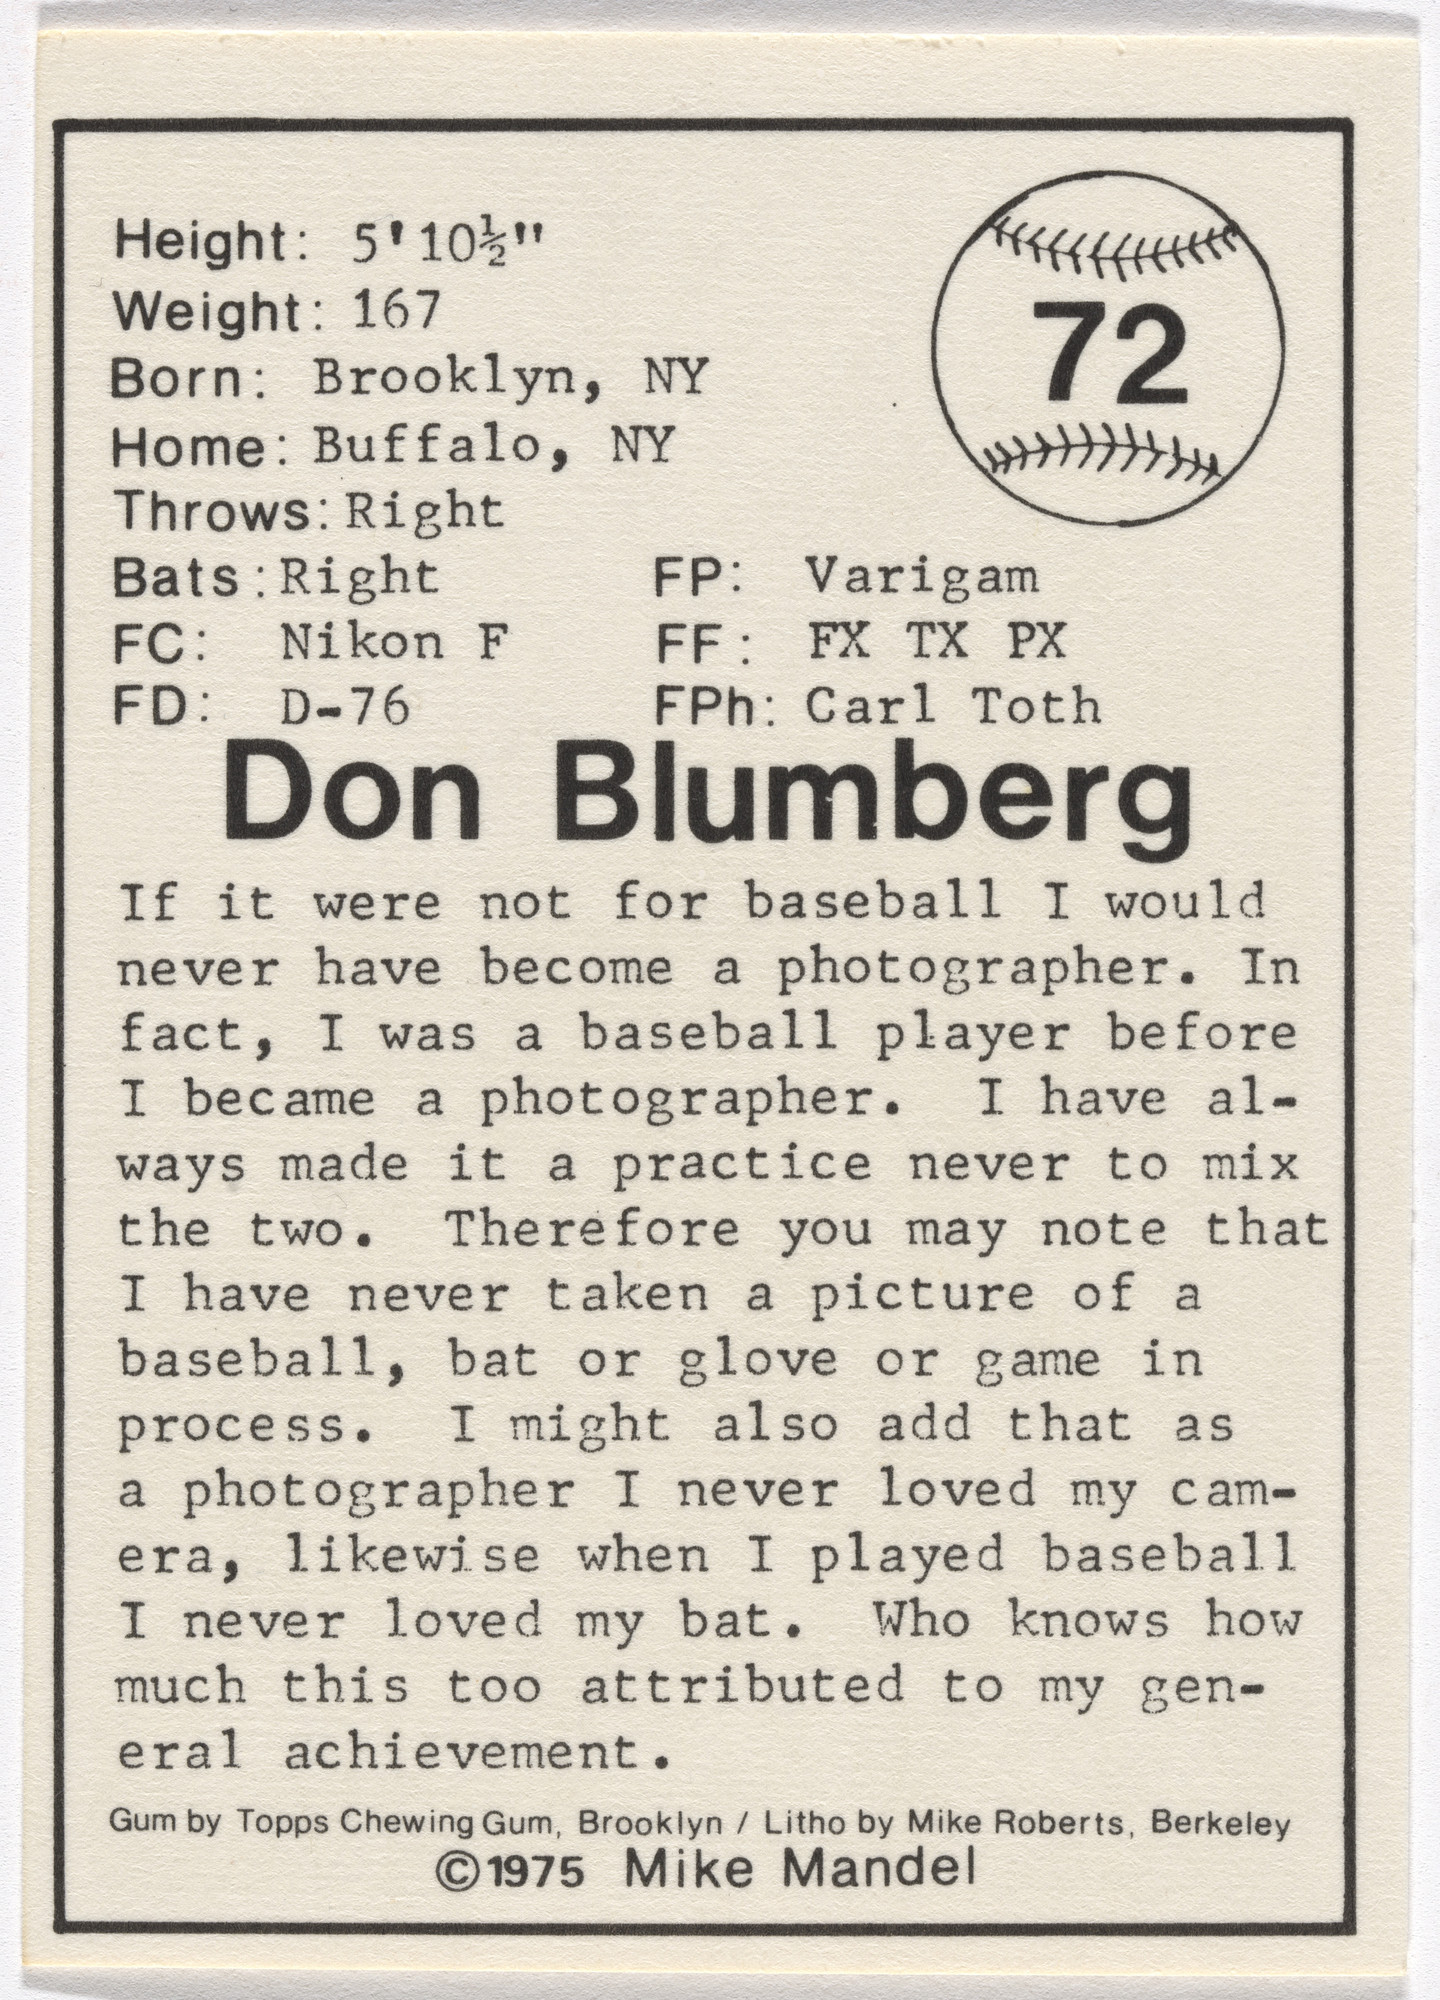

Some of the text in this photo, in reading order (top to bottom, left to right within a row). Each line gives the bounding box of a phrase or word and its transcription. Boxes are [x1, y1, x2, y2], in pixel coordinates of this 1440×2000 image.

[115, 217, 307, 271] Height:
[111, 287, 440, 342] Weight: 167
[110, 352, 710, 406] Born: Brooklyn, NY
[1033, 300, 1189, 405] 72
[112, 420, 676, 473] Home: Buffalo, NY
[113, 487, 505, 541] Throws: Right
[279, 552, 439, 606] Right
[654, 554, 1040, 605] FP: Varigam
[114, 618, 509, 665] FC: Nikon F
[808, 619, 871, 660] FX
[905, 620, 969, 659] TX
[1007, 620, 1068, 659] PX
[114, 683, 410, 726] FD: D-76
[655, 681, 1102, 727] FPh: Carl Toth
[225, 736, 1191, 865] Don Blumberg
[119, 876, 1266, 922] If it were not for baseball I would
[116, 942, 1301, 997] never have become a photographer. In
[121, 1007, 1297, 1063] fact, I was a baseball player before
[120, 1073, 1297, 1128] I became a photographer. I have al-
[115, 1140, 1299, 1194] ways made it a practice never to mix
[119, 1204, 1329, 1259] the two. Therefore you may note that
[120, 1269, 1202, 1323] I have never taken a picture of a
[117, 1334, 1203, 1388] baseball, bat or glove or game in
[118, 1399, 1233, 1454] process. I might also add that as
[119, 1464, 1297, 1520] a photographer I never loved my cam-
[118, 1530, 1296, 1585] era, likewise when I played baseball
[120, 1596, 1304, 1651] I never loved my bat. Who knows how
[113, 1662, 1265, 1716] much this too attributed to my gen-
[118, 1727, 669, 1770] eral achievement.
[109, 1806, 176, 1833] Gum
[187, 1808, 222, 1838] by
[236, 1808, 329, 1839] Topps
[340, 1807, 474, 1840] Chewing
[482, 1809, 561, 1839] Gum,
[579, 1809, 722, 1841] Brooklyn
[765, 1809, 846, 1836] Litho
[858, 1808, 894, 1840] by
[908, 1808, 982, 1835] Mike
[995, 1808, 1134, 1839] Roberts,
[1151, 1808, 1291, 1843] Berkeley
[625, 1846, 753, 1889] Mike
[783, 1844, 975, 1889] Mandel
